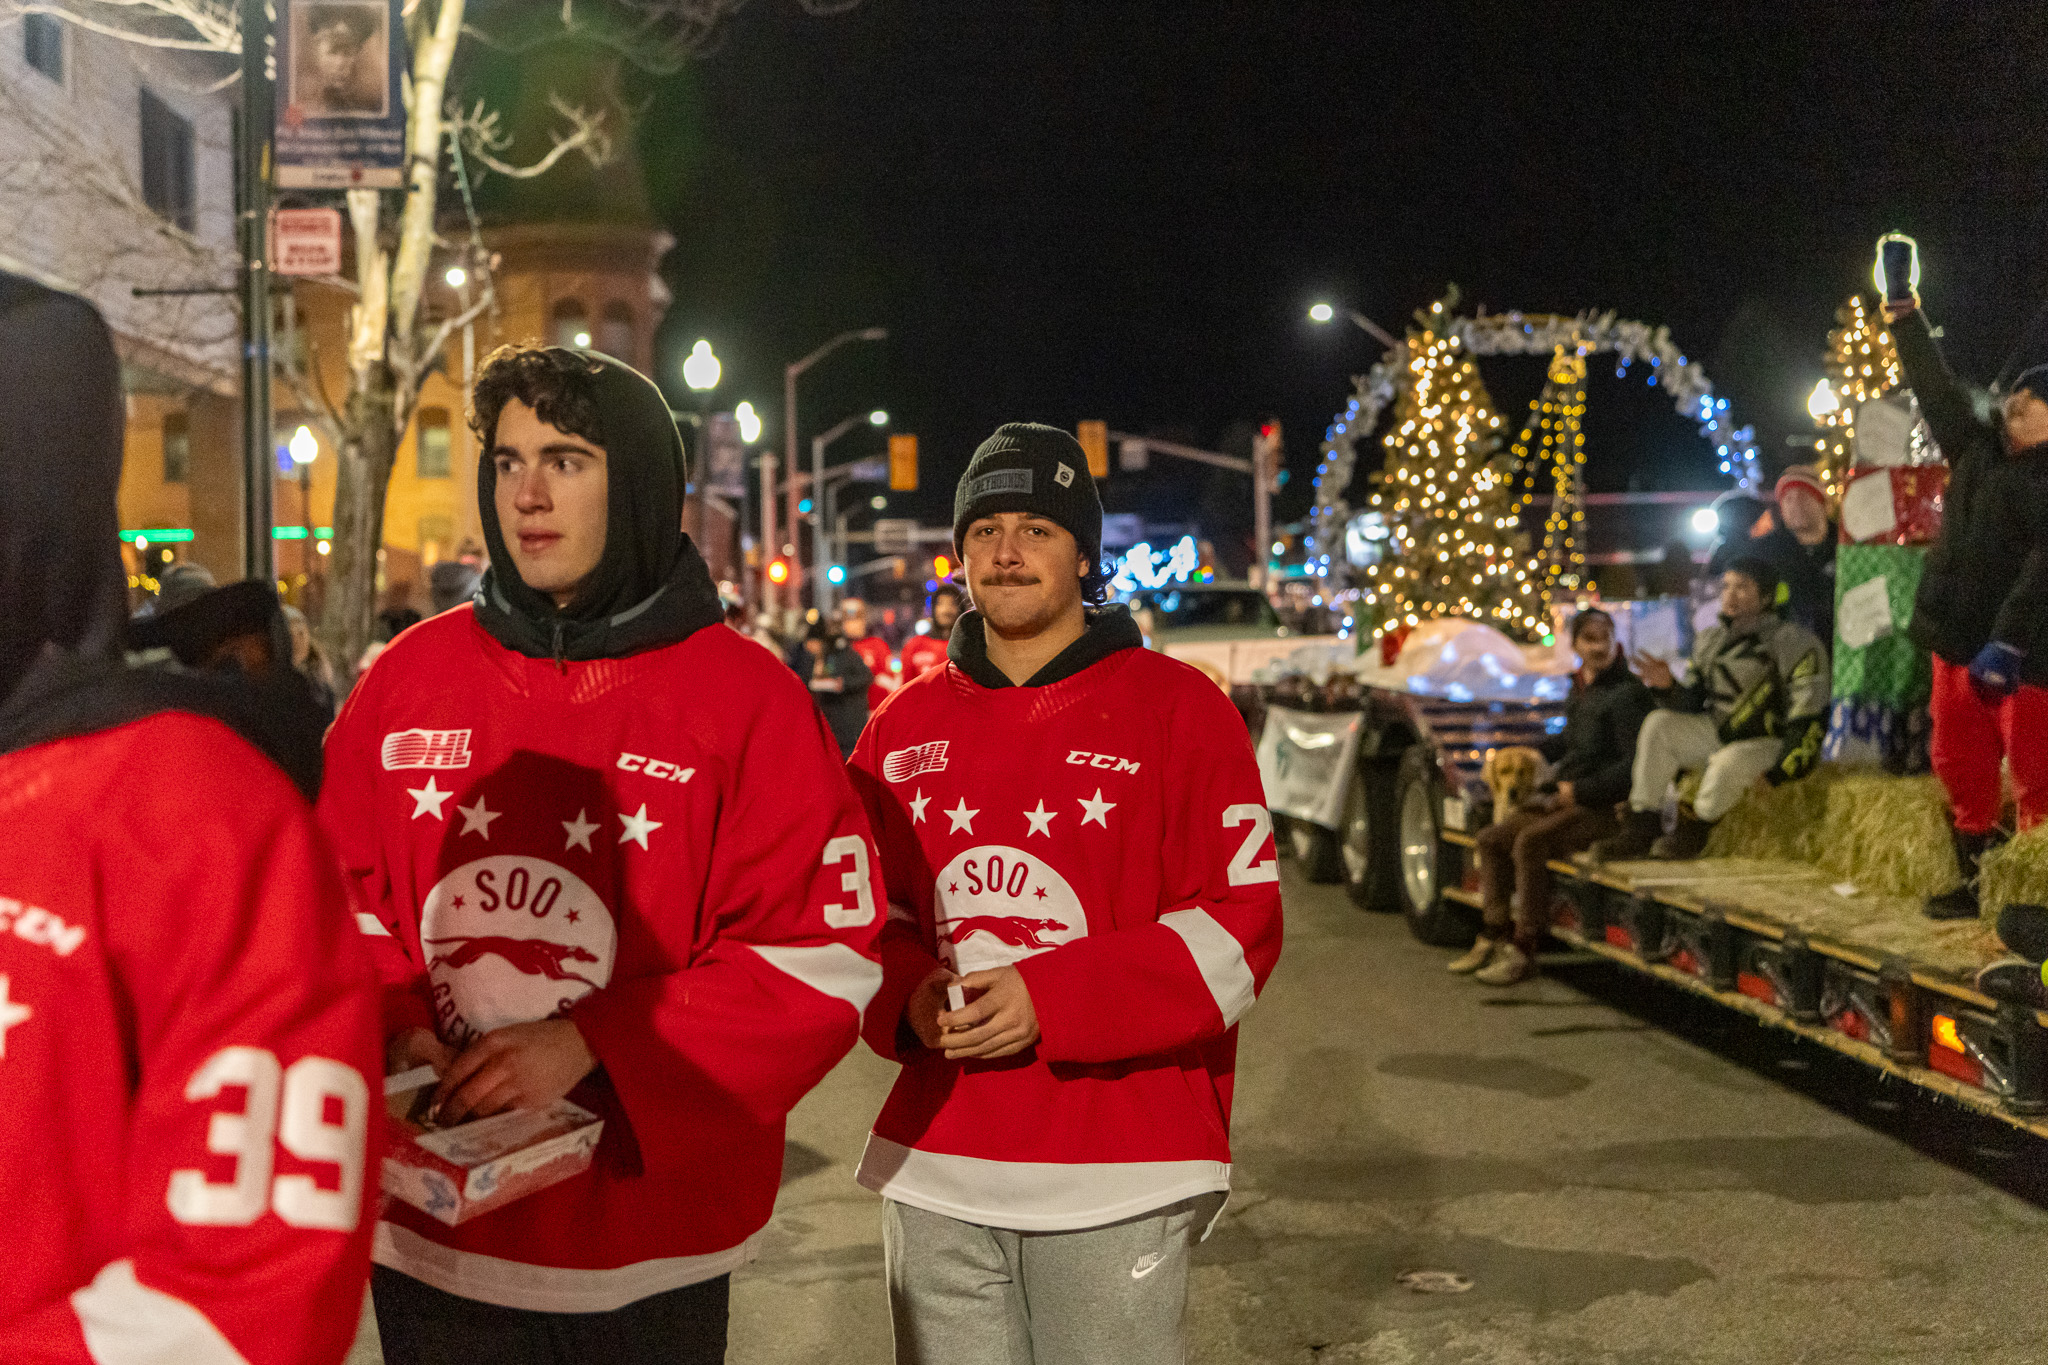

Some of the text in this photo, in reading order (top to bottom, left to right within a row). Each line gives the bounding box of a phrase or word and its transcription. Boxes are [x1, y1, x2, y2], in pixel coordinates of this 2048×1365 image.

[616, 752, 696, 783] CCM
[1066, 750, 1141, 775] CCM
[475, 867, 562, 918] SOO
[963, 855, 1029, 898] SOO
[166, 1045, 370, 1233] 39
